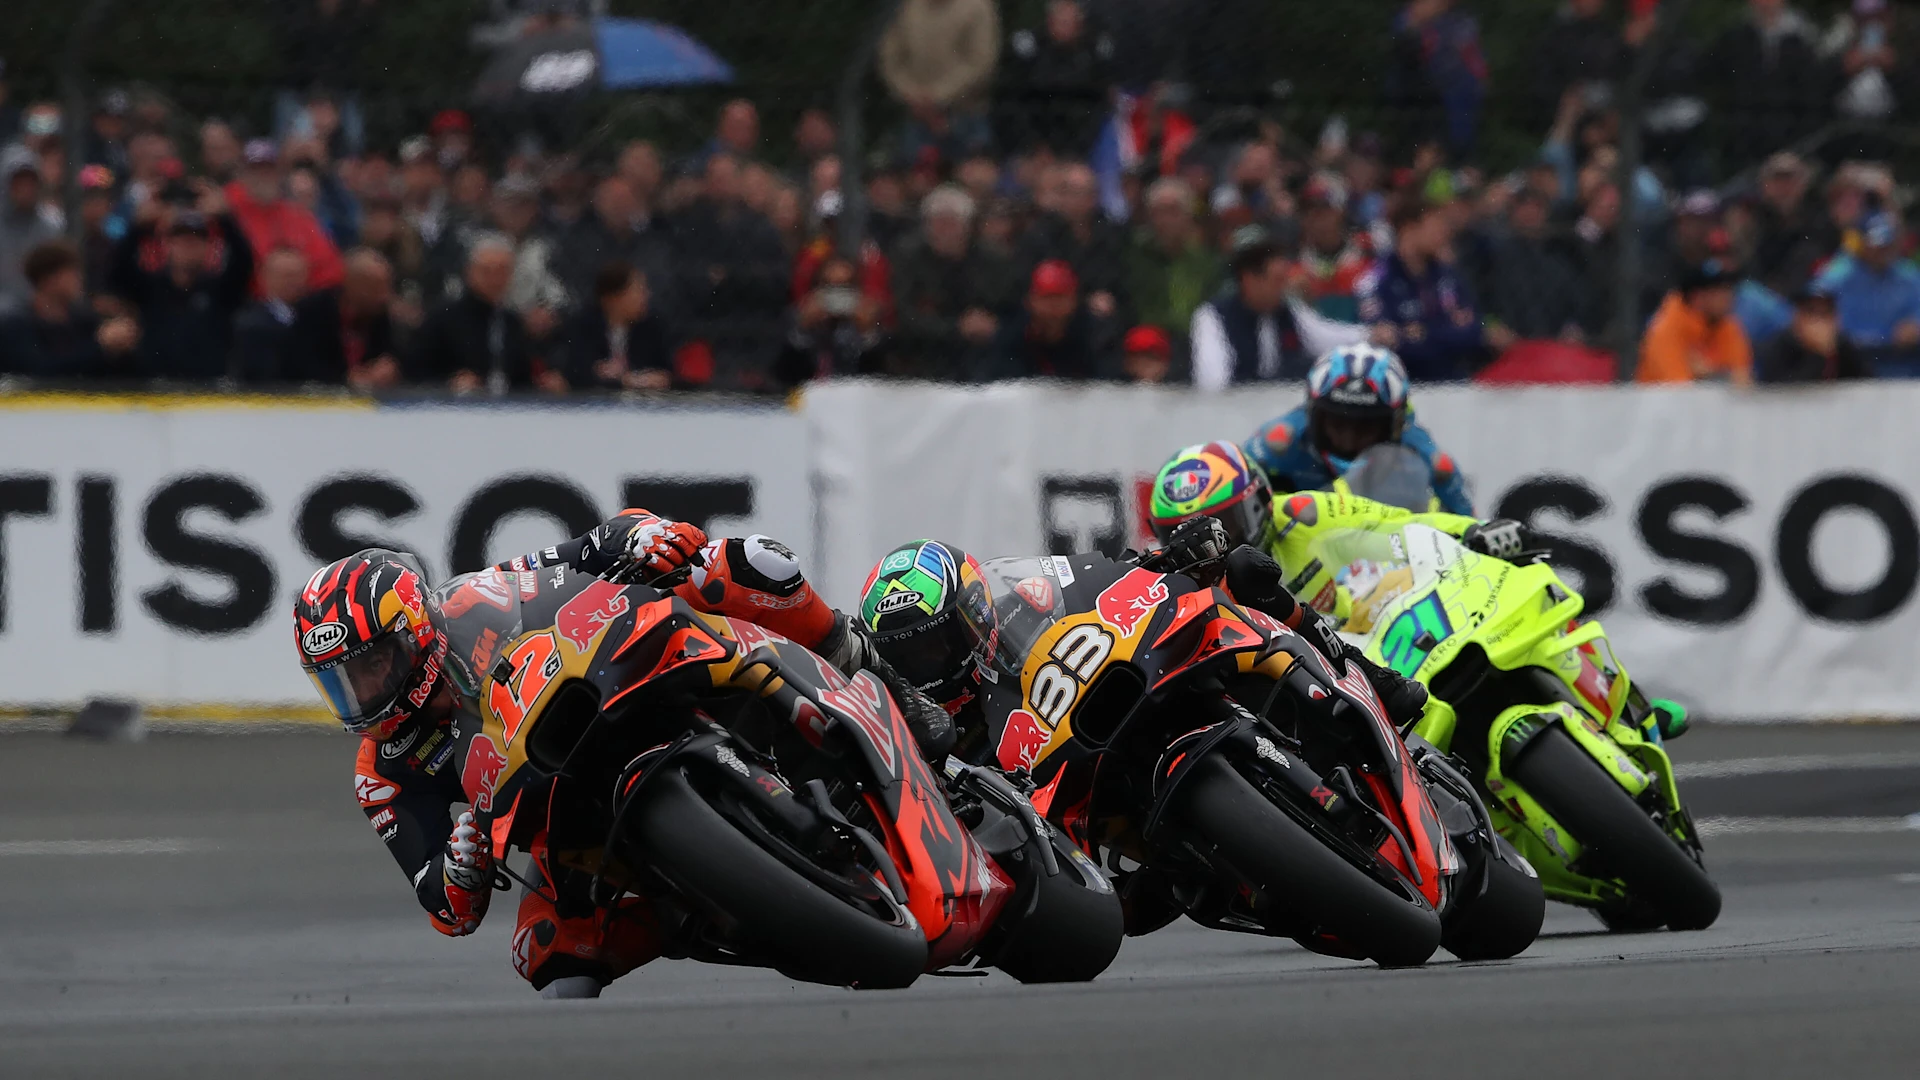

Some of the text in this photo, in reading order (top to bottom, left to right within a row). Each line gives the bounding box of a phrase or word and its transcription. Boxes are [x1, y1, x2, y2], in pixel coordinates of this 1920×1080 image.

[880, 593, 921, 612] HJC
[917, 614, 951, 633] WINGS
[306, 625, 340, 649] Arai
[470, 627, 499, 678] KTM
[1381, 588, 1455, 678] 21
[1422, 637, 1457, 673] HERO
[488, 630, 558, 751] 12
[1028, 622, 1115, 732] 33
